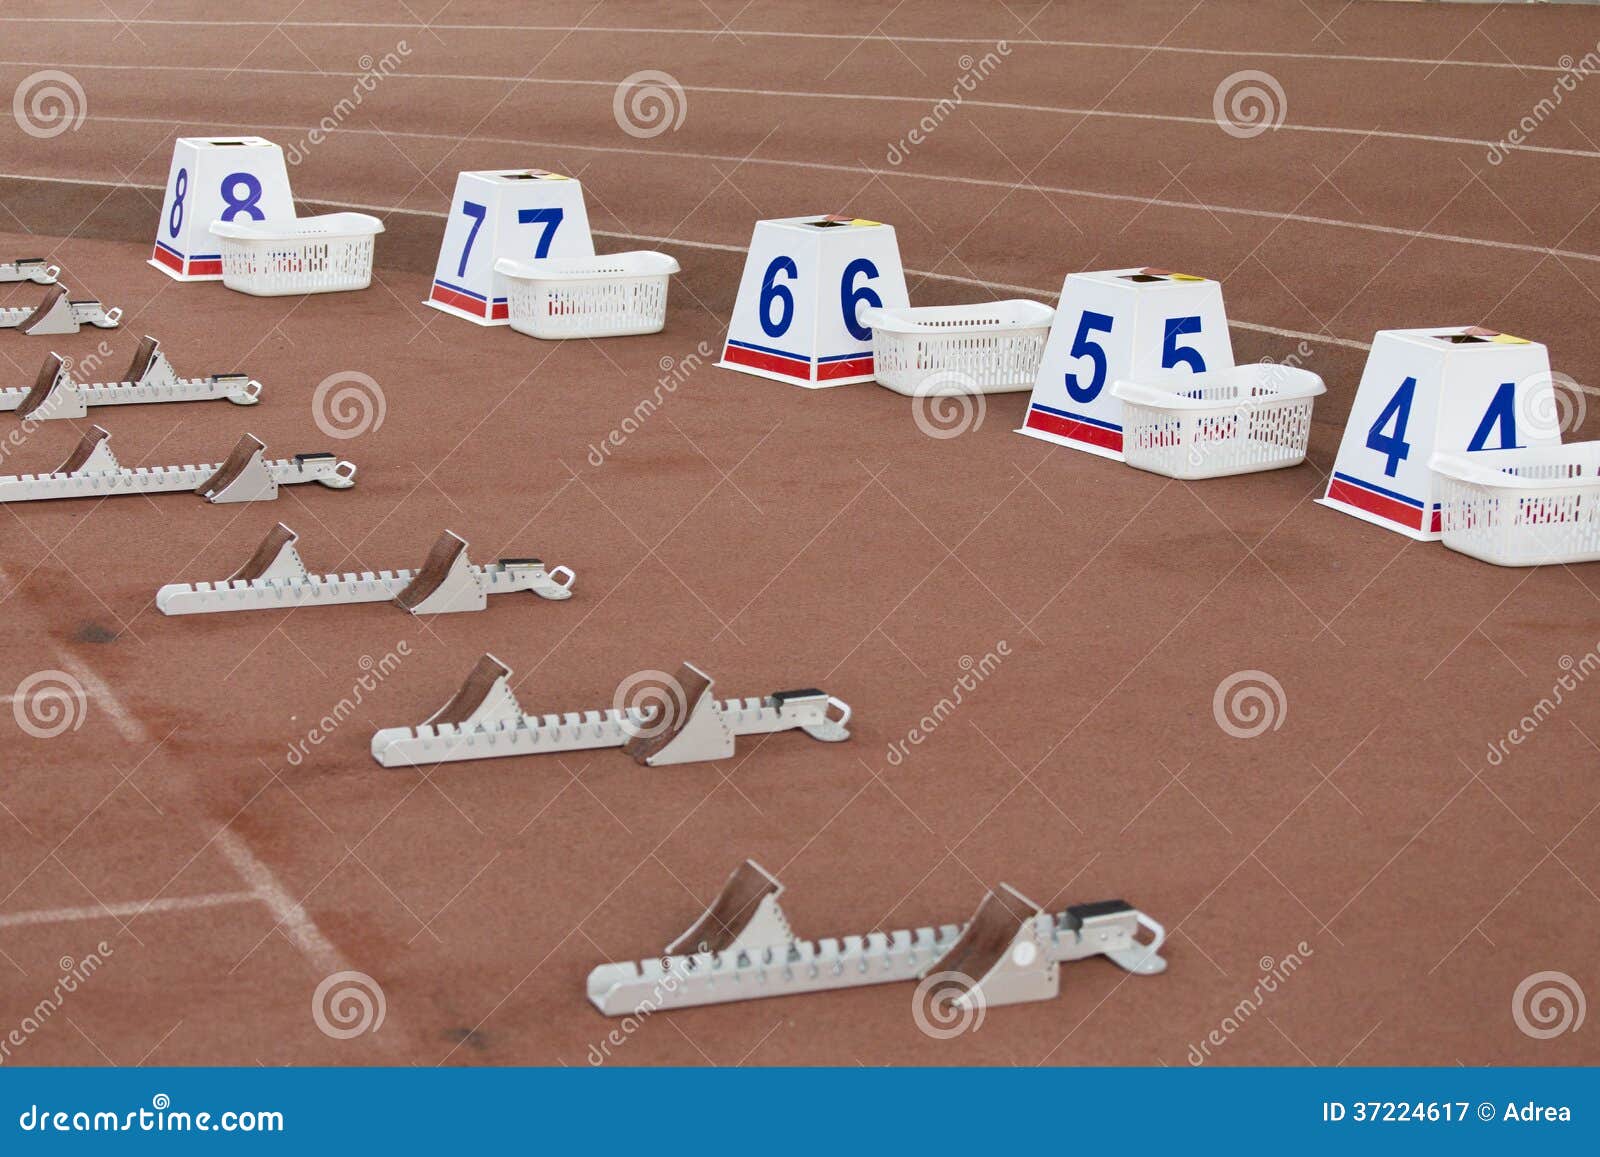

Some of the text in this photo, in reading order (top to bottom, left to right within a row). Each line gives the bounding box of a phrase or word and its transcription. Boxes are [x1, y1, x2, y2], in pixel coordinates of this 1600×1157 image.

[169, 168, 187, 238] 8
[220, 172, 264, 223] 8
[517, 207, 564, 260] 7
[457, 200, 487, 278] 7
[758, 255, 798, 338] 6
[840, 257, 883, 341] 6
[1064, 310, 1114, 404] 5
[1161, 315, 1207, 374] 5
[1365, 376, 1418, 478] 4
